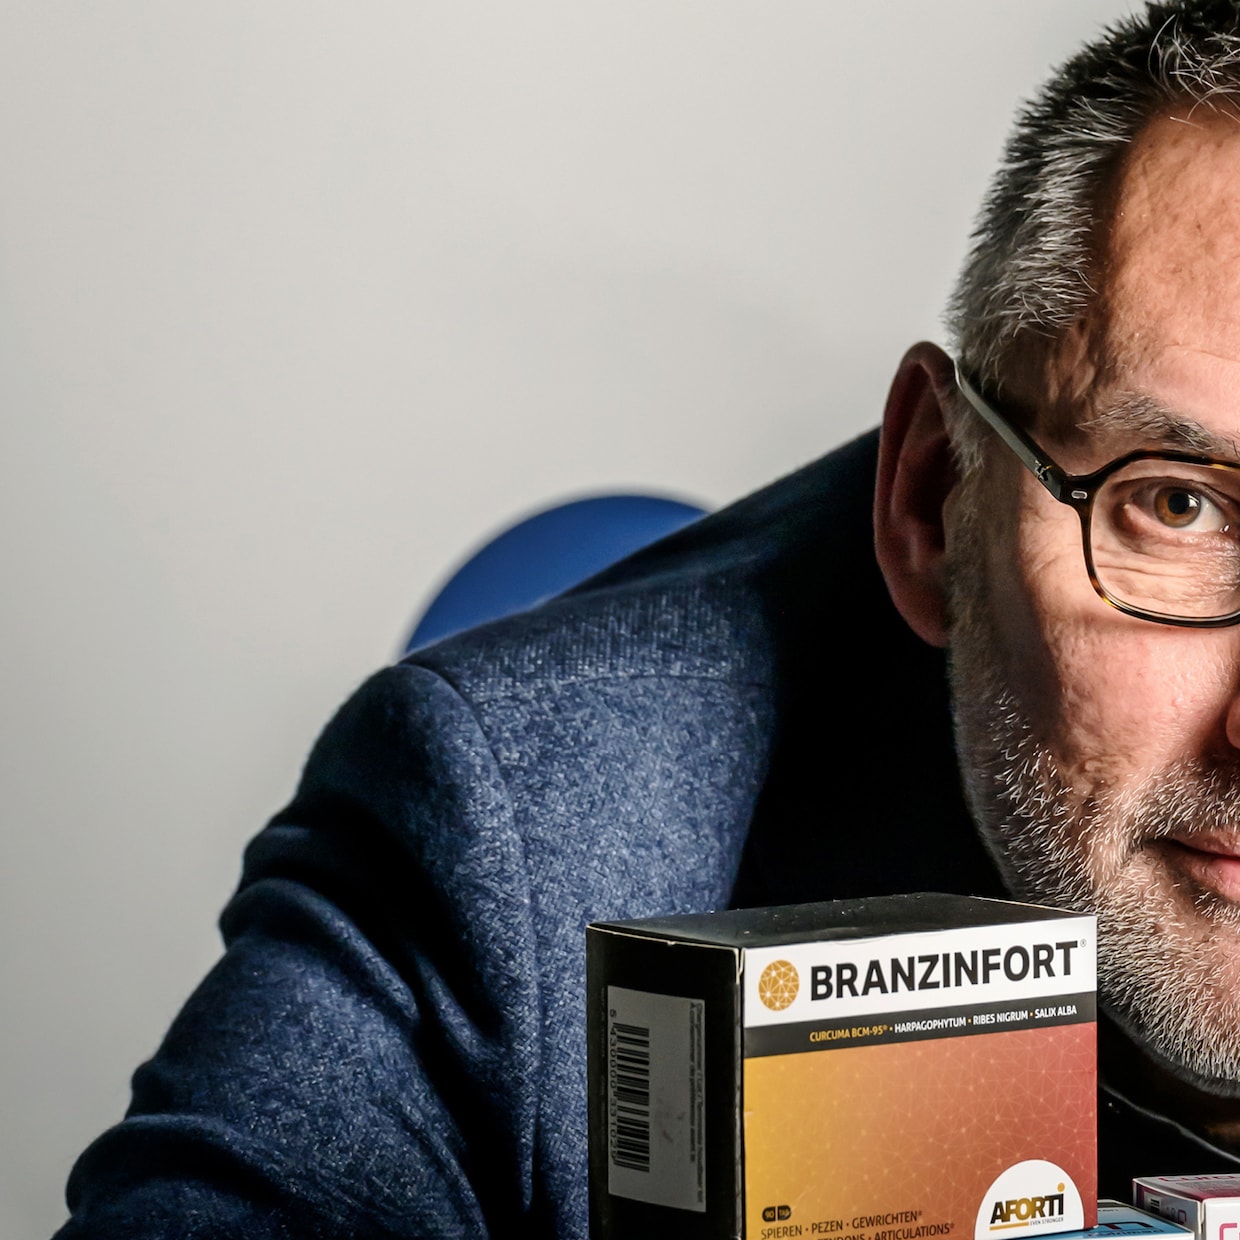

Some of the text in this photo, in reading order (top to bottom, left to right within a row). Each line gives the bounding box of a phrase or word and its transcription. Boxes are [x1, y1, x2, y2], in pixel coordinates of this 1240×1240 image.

[809, 1026, 850, 1043] CURCUMA
[894, 1016, 967, 1034] HARPAGOPHYTUM
[973, 1013, 996, 1026] RIBES
[996, 1010, 1029, 1024] NIGRUM
[1034, 1007, 1056, 1020] SALIX
[1057, 1004, 1077, 1017] ALBA
[761, 1224, 802, 1240] SPIEREN
[811, 1220, 843, 1235] PEZEN
